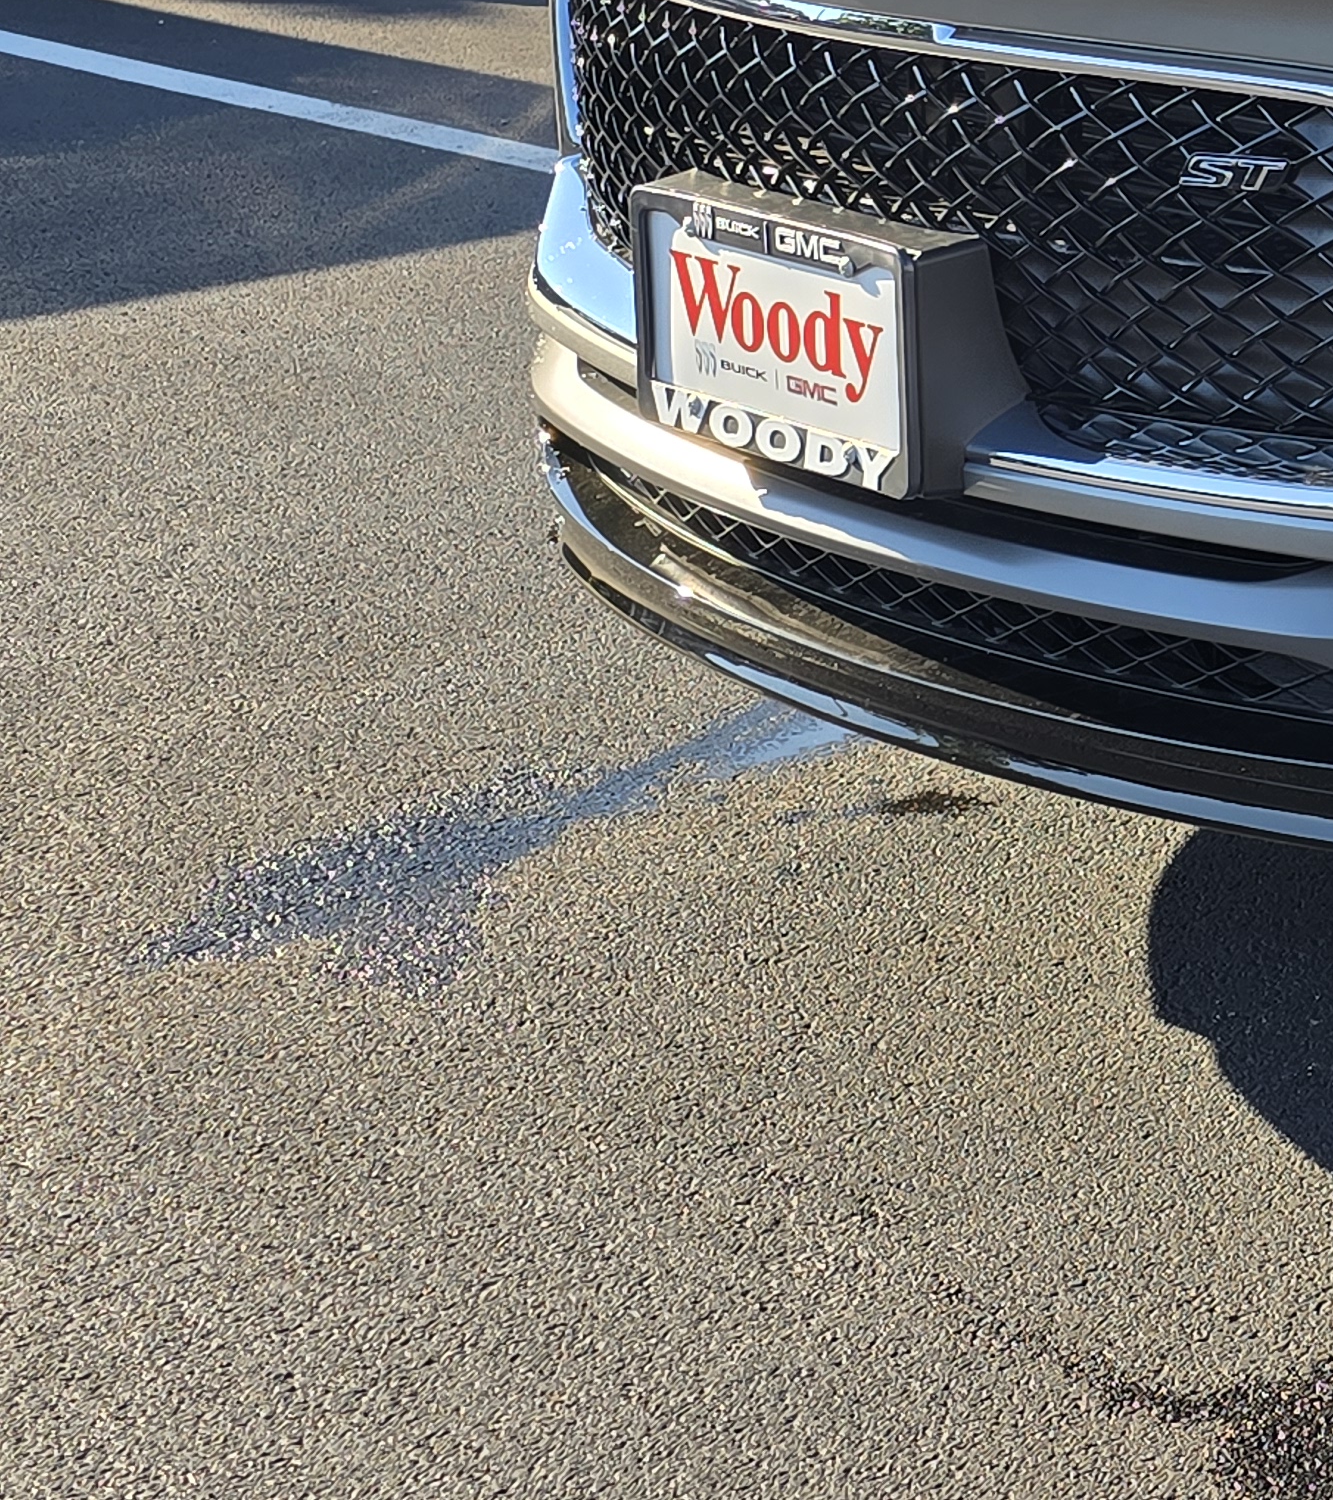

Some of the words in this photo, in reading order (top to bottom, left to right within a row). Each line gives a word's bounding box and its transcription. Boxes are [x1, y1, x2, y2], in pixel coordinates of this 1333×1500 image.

[1179, 155, 1287, 191] ST
[715, 216, 761, 239] BUICK
[775, 226, 843, 265] GMC
[670, 249, 883, 403] Woody
[720, 359, 768, 382] BUICK
[786, 375, 838, 406] GMC
[651, 381, 898, 491] WOODY
